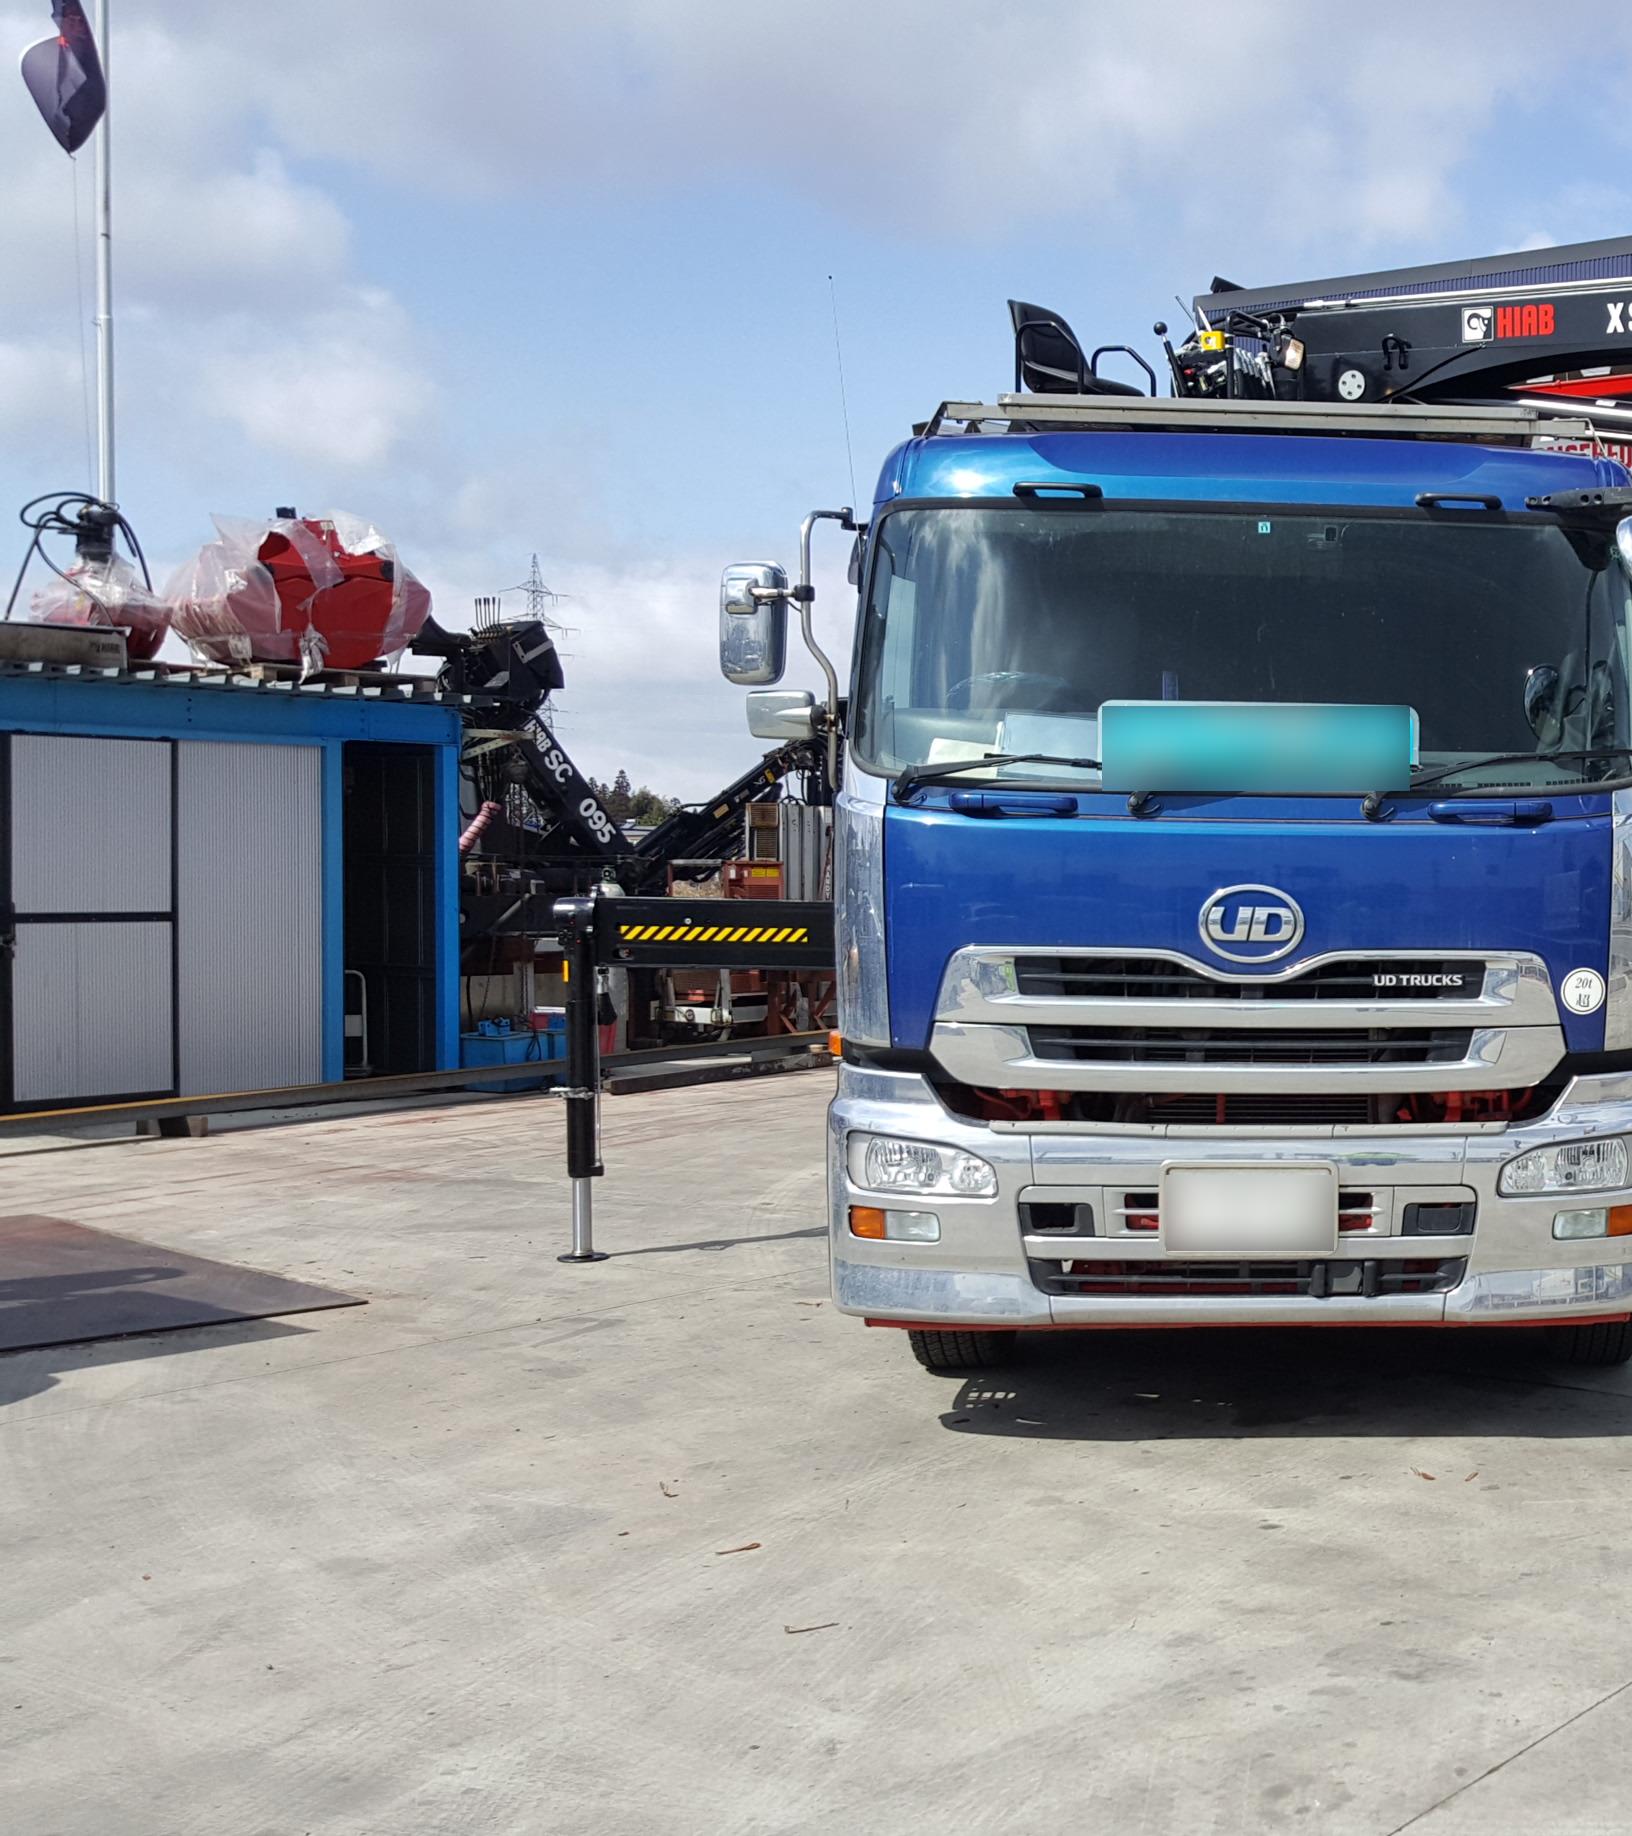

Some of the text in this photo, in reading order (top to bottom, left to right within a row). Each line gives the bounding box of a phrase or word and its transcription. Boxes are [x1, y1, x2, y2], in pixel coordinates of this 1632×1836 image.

[1497, 303, 1555, 338] HIAB
[544, 749, 573, 784] SC
[579, 798, 617, 844] 095
[1208, 906, 1295, 942] UD
[1373, 974, 1463, 987] UD TRUCKS
[1575, 977, 1592, 989] 20t
